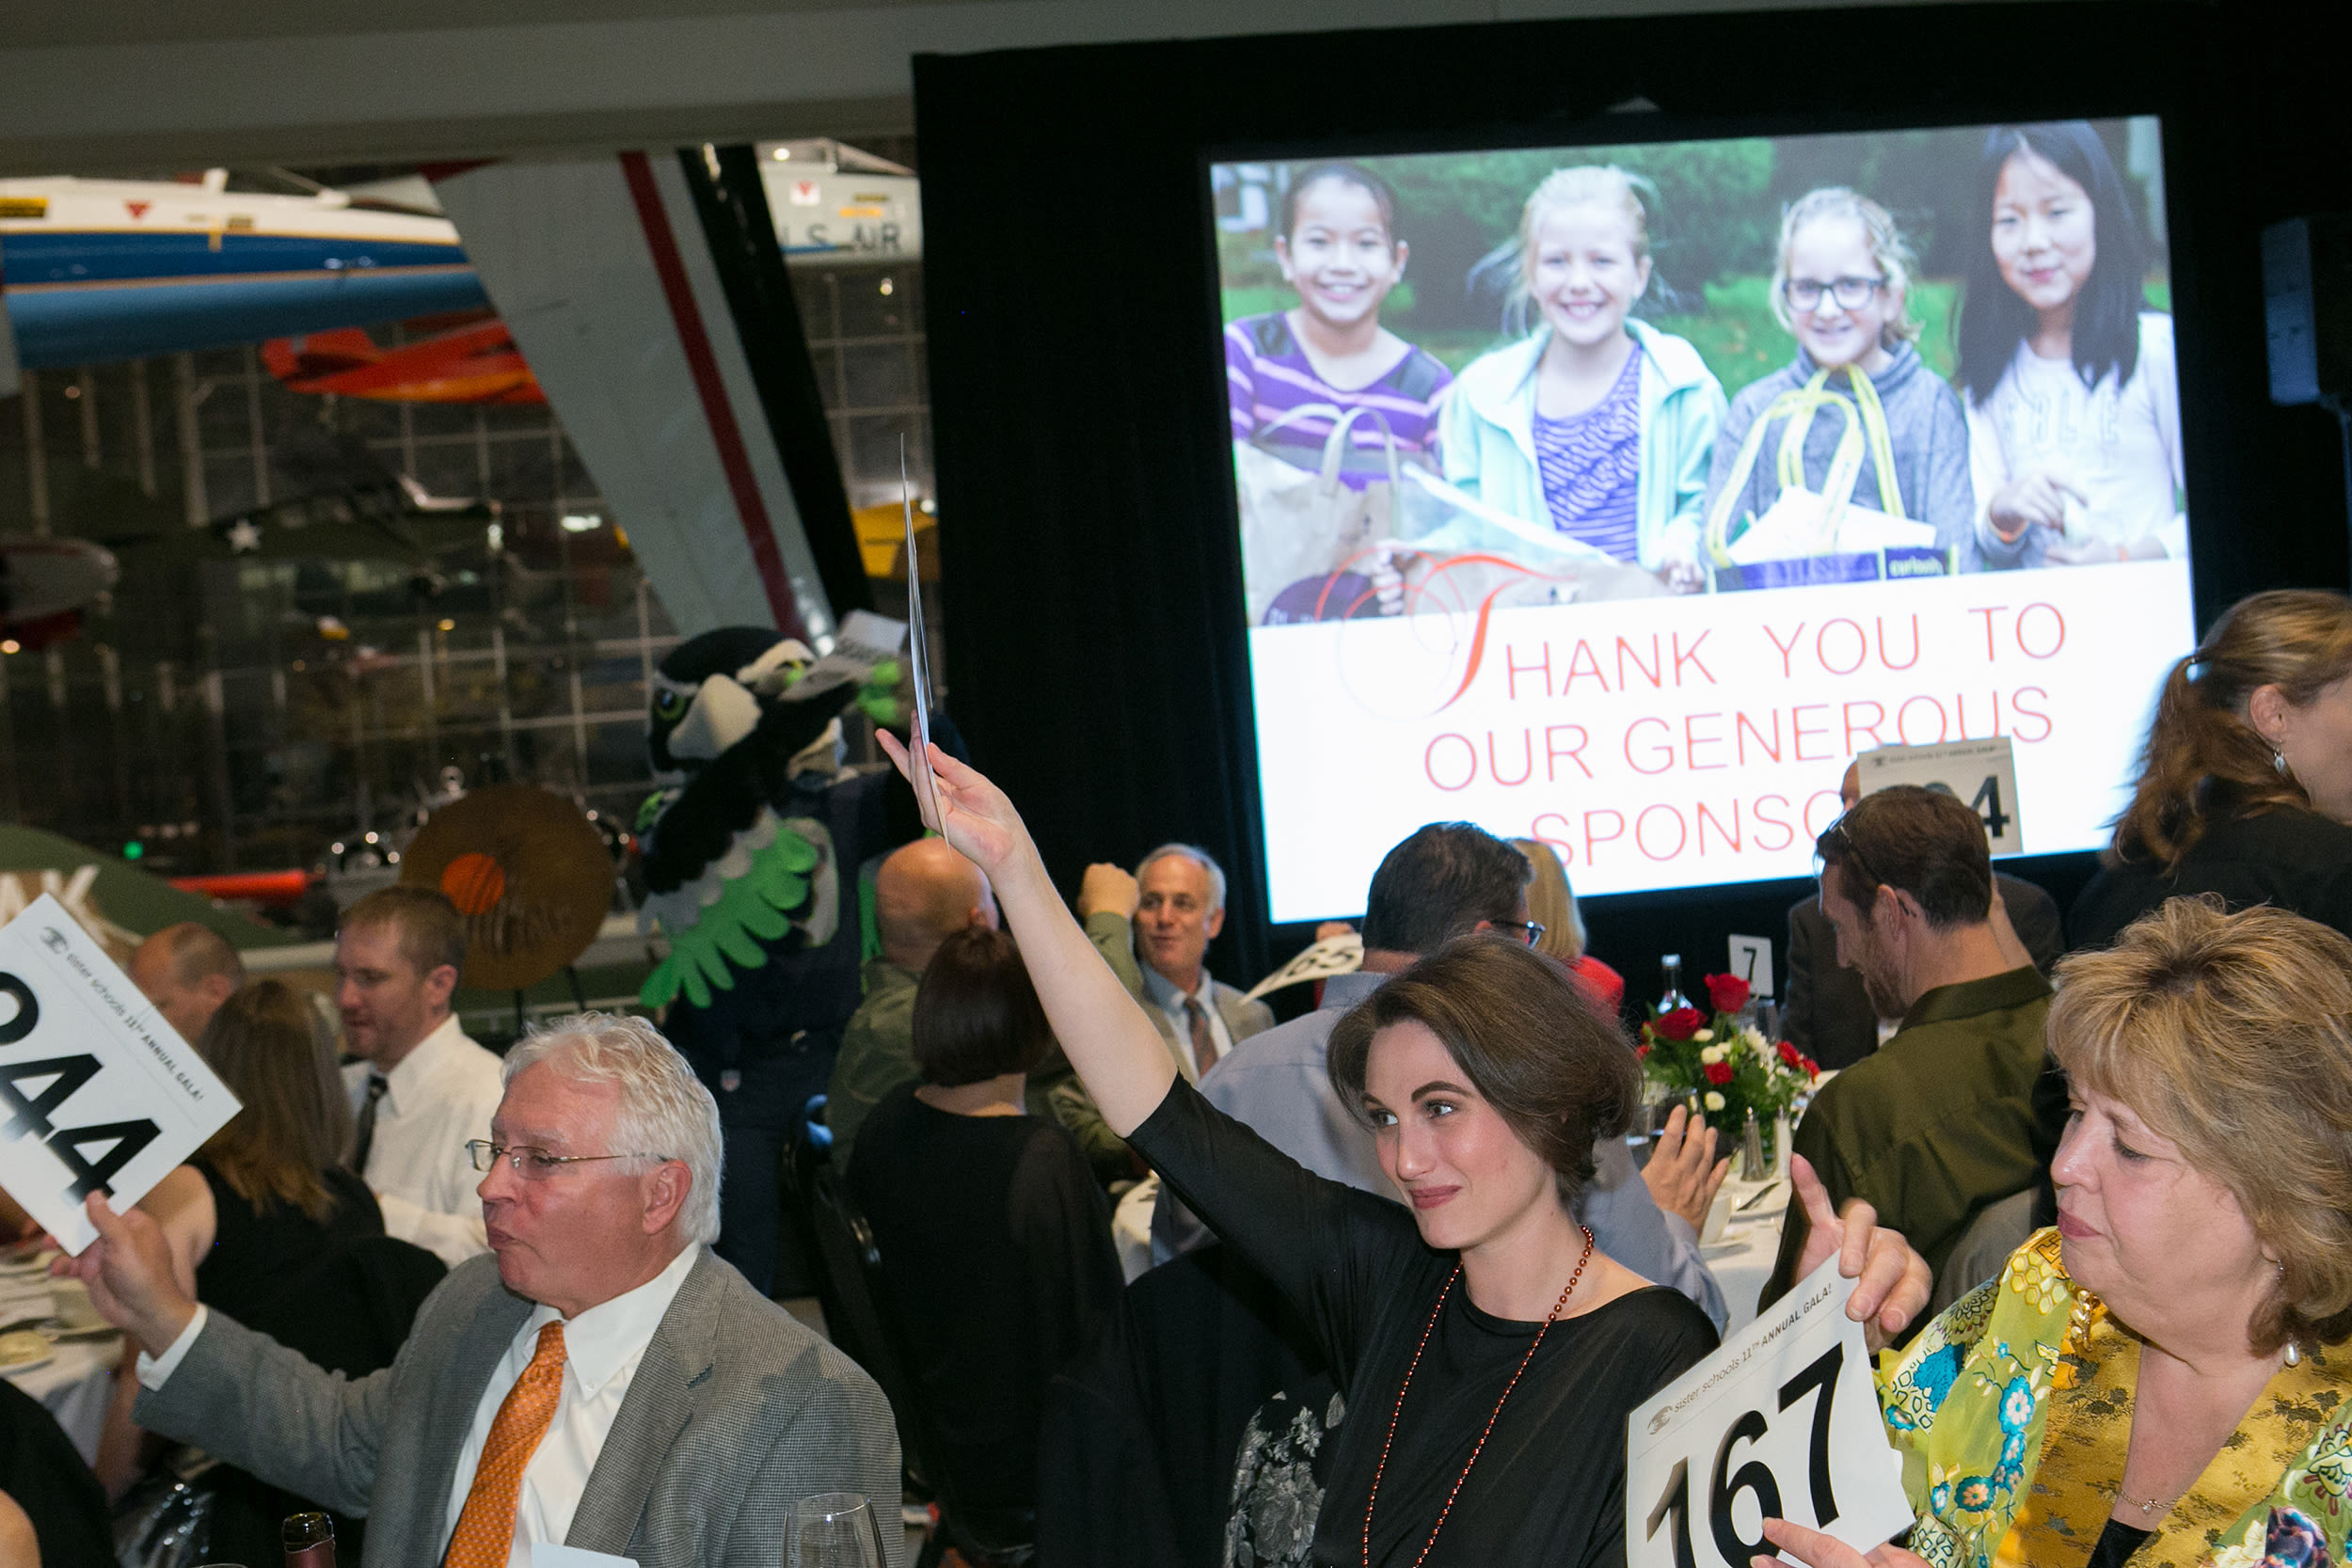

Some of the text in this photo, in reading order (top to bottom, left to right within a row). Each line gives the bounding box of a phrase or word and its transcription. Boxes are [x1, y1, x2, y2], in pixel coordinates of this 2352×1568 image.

[1762, 612, 1920, 678] YOU
[1967, 602, 2066, 662] TO
[1424, 686, 2053, 791] OUR GENEROUS
[1742, 946, 1757, 983] 7
[141, 1035, 178, 1075] ANNUAL
[176, 1071, 205, 1103] GALA!
[1674, 1386, 1701, 1413] sister
[1702, 1358, 1740, 1391] schools
[1761, 1311, 1802, 1349] ANNUAL
[1803, 1283, 1833, 1315] GALA!
[1646, 1340, 1845, 1568] 167
